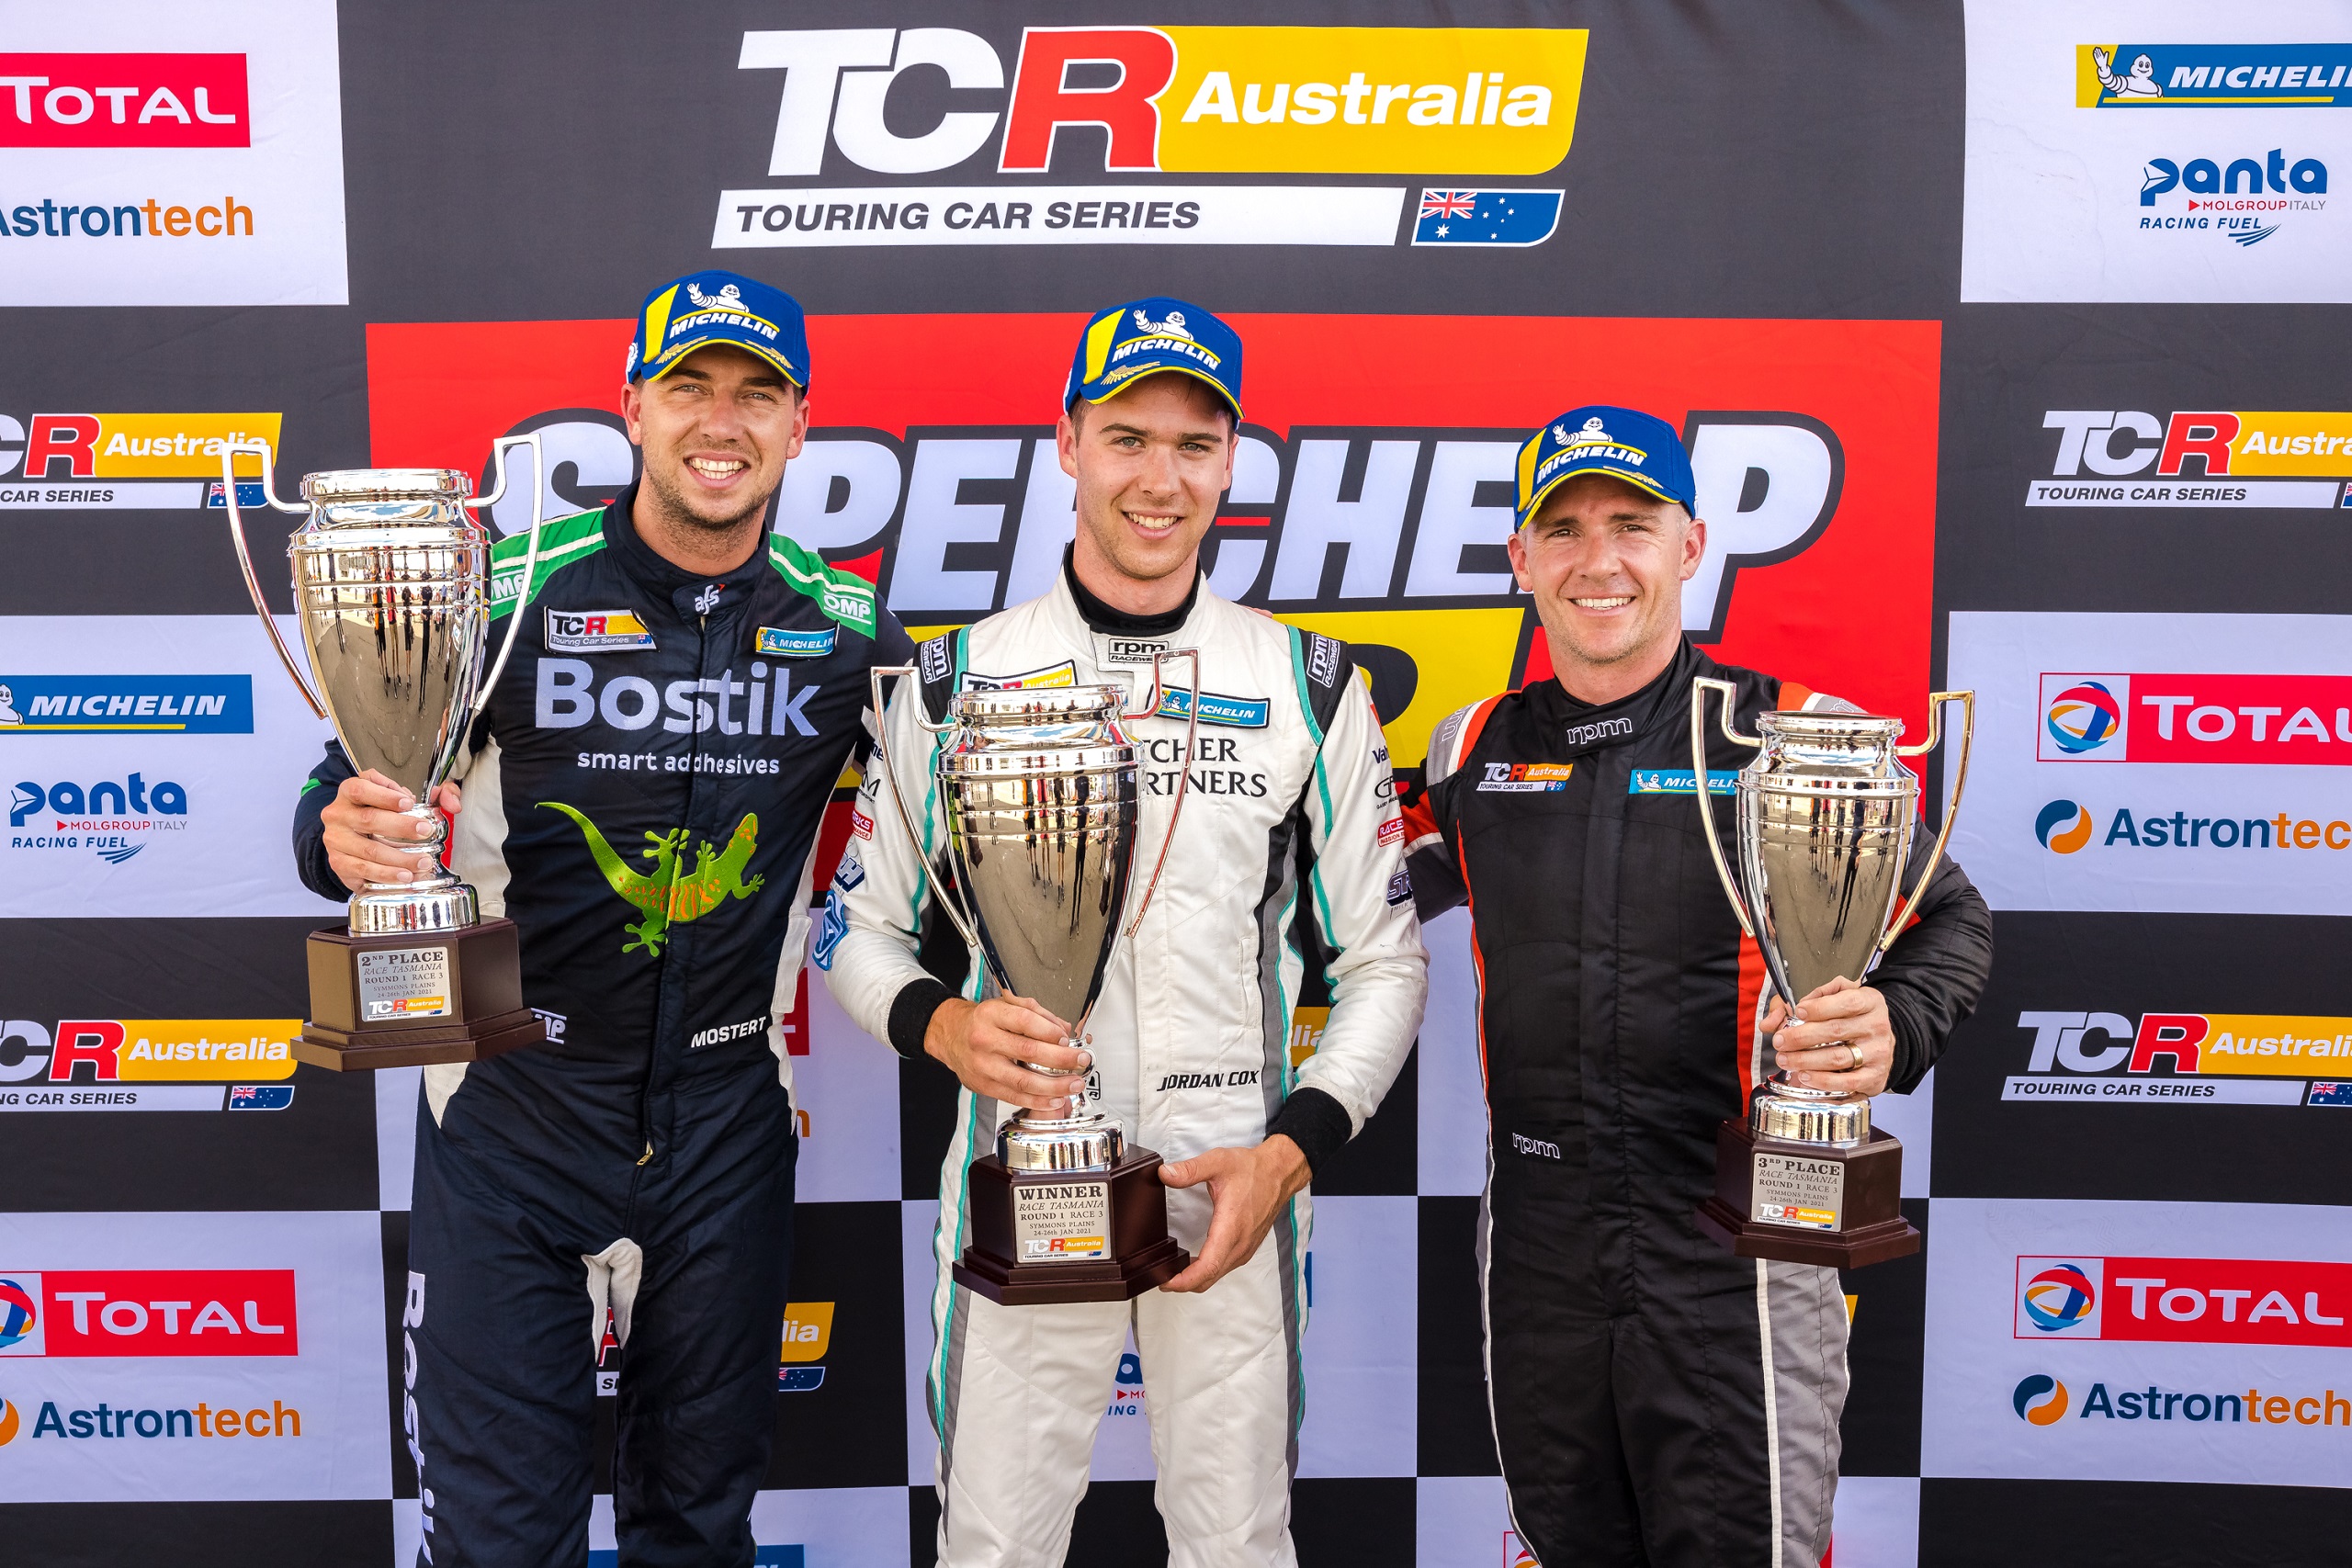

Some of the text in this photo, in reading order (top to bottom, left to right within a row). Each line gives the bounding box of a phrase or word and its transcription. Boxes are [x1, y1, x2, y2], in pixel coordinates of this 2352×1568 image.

[0, 76, 236, 124] TOTAL
[737, 25, 1553, 176] TCR Australia
[2140, 148, 2328, 207] panta
[736, 200, 1201, 232] TOURING CAR SERIES
[2140, 217, 2262, 229] RACING FUEL
[669, 312, 778, 341] MICHELIN
[1112, 339, 1220, 371] MICHELIN
[2042, 411, 2352, 476] TCR Austr
[1536, 446, 1645, 484] MICHELIN
[0, 490, 114, 502] CAR SERIES
[2037, 488, 2247, 501] TOURING CAR SERIES
[492, 574, 524, 599] MP
[823, 594, 871, 618] OMP
[552, 615, 607, 636] TCR
[552, 636, 581, 647] Touring
[602, 636, 629, 645] Series
[780, 636, 834, 649] MICHELIN
[1114, 642, 1166, 655] rpm
[1311, 636, 1328, 677] rpm
[28, 695, 226, 716] MICHELIN
[535, 658, 821, 736] Bostik
[1566, 717, 1633, 744] rpm
[577, 752, 657, 771] smart
[1485, 762, 1569, 782] TCR Australia
[1146, 770, 1268, 797] RTNERS
[1664, 777, 1735, 788] MICELI
[10, 772, 187, 827] panta
[2104, 808, 2352, 850] Astrontec
[12, 837, 129, 848] RACING FUEL
[389, 952, 444, 964] PLACE
[364, 964, 443, 975] RACE TASMANIA
[368, 998, 408, 1014] TCR
[691, 1016, 766, 1048] MOSTERT
[2018, 1011, 2352, 1074] TCR Australi
[0, 1020, 288, 1081] CR Australia
[1157, 1070, 1259, 1091] JORDAN COX
[2012, 1083, 2215, 1098] TOURING CAR SERIES
[25, 1093, 64, 1105] CAR
[69, 1092, 137, 1105] SERIES
[1512, 1132, 1560, 1159] rpm
[1758, 1169, 1838, 1184] RACE TASMANIA
[1784, 1160, 1840, 1176] PLACE
[1018, 1185, 1102, 1201] WINNER
[1758, 1179, 1792, 1189] ROUND
[1806, 1184, 1829, 1192] RACE
[1766, 1189, 1801, 1198] SYMMONS
[1018, 1201, 1103, 1211] RACE TASMANIA
[1759, 1203, 1833, 1220] TCR Australia
[1021, 1213, 1057, 1221] ROUND
[1024, 1237, 1066, 1253] TCR
[2115, 1278, 2344, 1325] TOTAL
[55, 1292, 285, 1336] TOTAL
[2079, 1382, 2351, 1427] Astrontech
[32, 1400, 301, 1438] Astrontech
